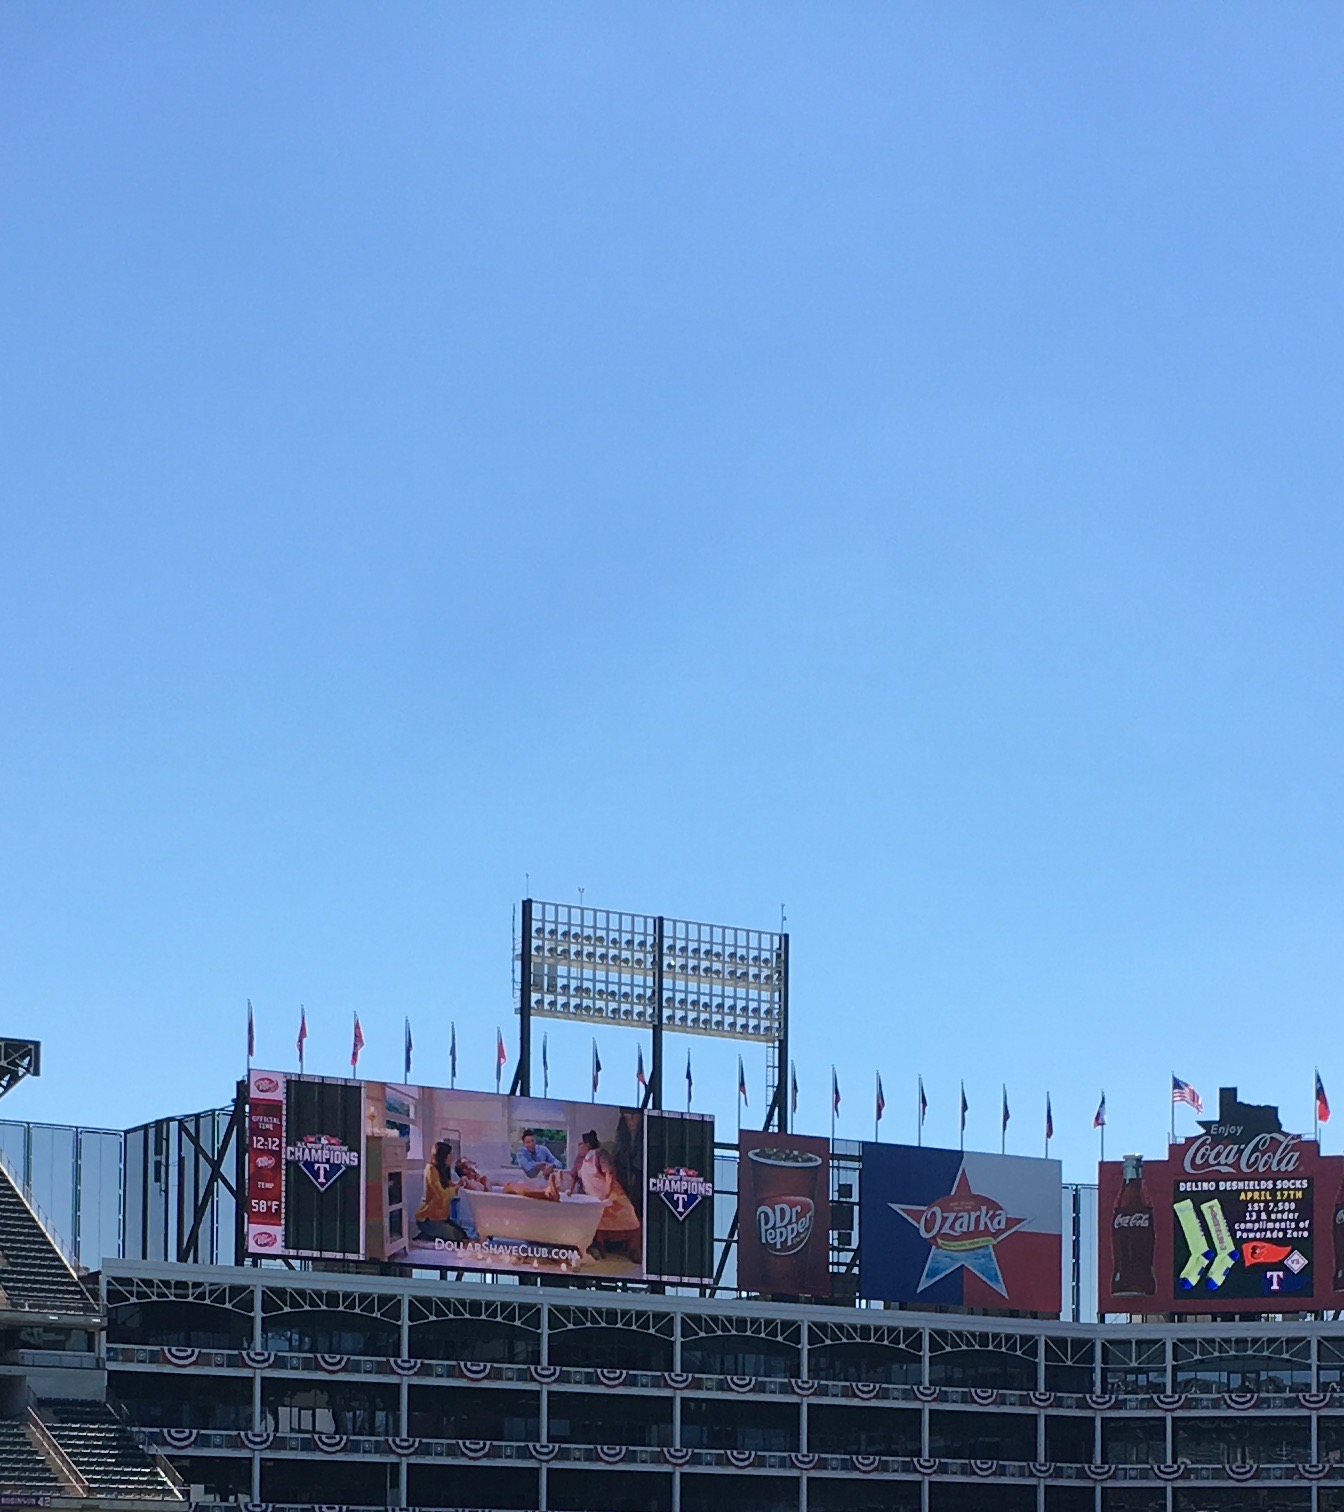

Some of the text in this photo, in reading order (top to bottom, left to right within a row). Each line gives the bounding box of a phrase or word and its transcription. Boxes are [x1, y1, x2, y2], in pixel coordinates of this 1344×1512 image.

[1210, 1124, 1244, 1136] Enjoy
[252, 1135, 280, 1151] 12:12
[286, 1146, 359, 1166] CHAMPIONS
[1183, 1132, 1301, 1174] Coca-Cola
[649, 1177, 713, 1196] CHAMPIONS
[1179, 1179, 1308, 1192] DELINO DESHIELDS SOCKS
[1239, 1190, 1303, 1201] APRIL 17TH
[1247, 1202, 1296, 1212] 1ST 7,500
[774, 1203, 802, 1228] Dr
[918, 1205, 1006, 1240] Ozarka
[1270, 1211, 1299, 1220] under
[756, 1205, 810, 1249] Pepper
[1234, 1219, 1309, 1232] compliments of
[1286, 1229, 1309, 1238] Zero
[1266, 1271, 1284, 1290] T
[38, 1497, 52, 1507] 42
